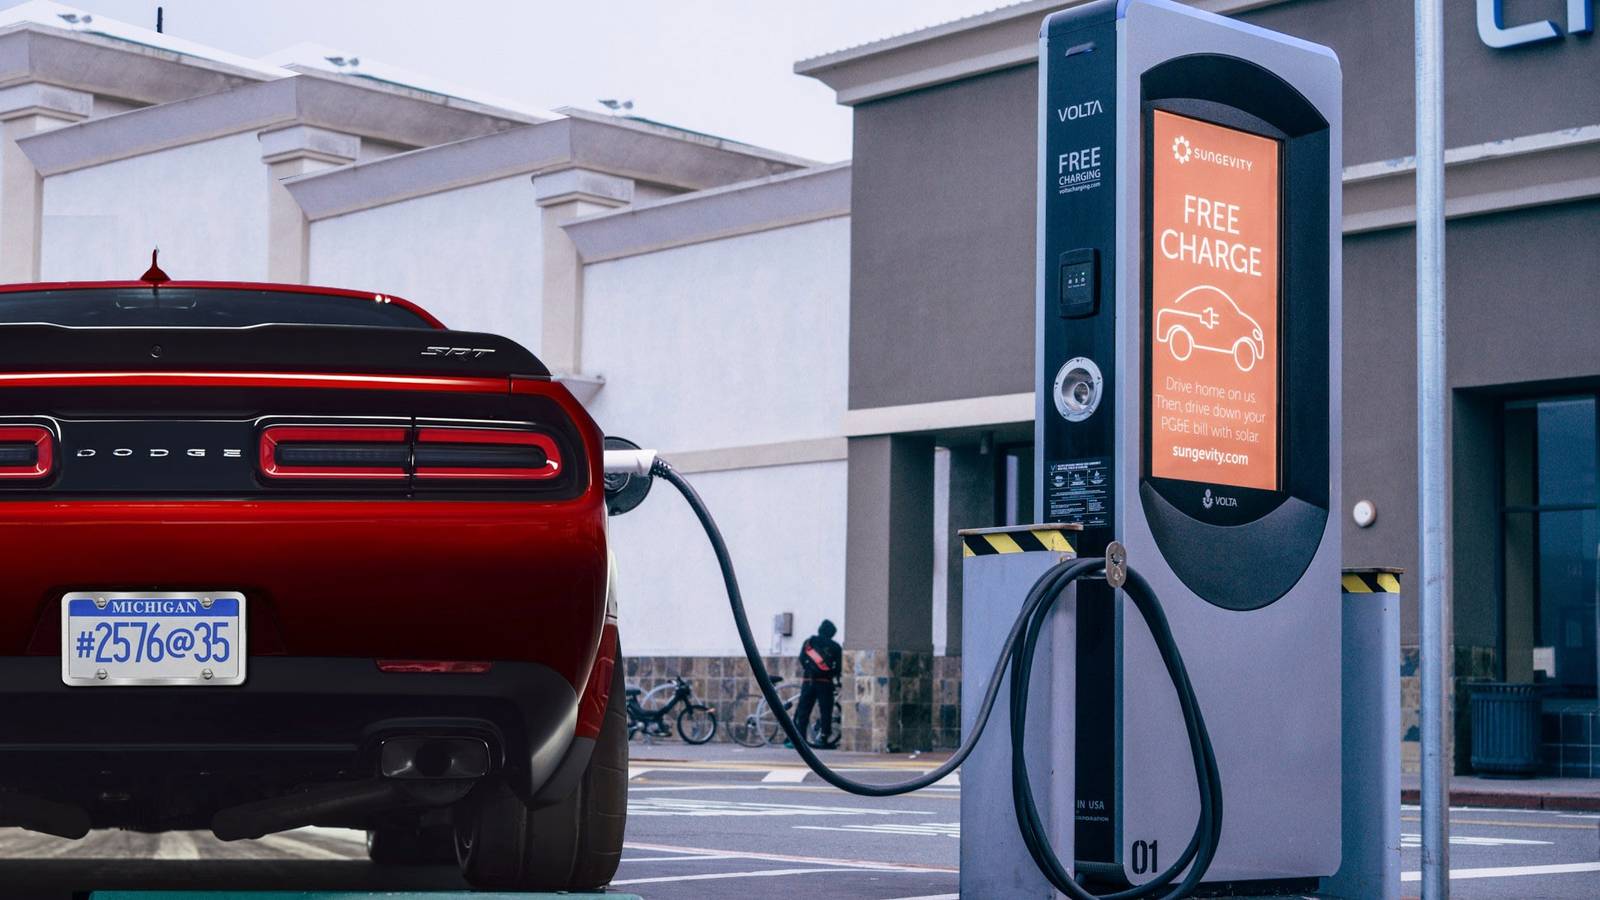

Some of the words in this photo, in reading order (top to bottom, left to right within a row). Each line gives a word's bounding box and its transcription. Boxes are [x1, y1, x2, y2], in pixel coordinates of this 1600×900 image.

[1058, 100, 1103, 122] VOLTA
[1059, 147, 1101, 174] FREE
[1194, 147, 1253, 171] SUNGEVITY
[1059, 169, 1101, 186] CHARGING
[1184, 194, 1240, 235] FREE
[1161, 229, 1263, 277] CHARGE
[420, 346, 497, 360] SRT
[1166, 376, 1193, 393] Drive
[1195, 382, 1225, 398] home
[1228, 391, 1241, 401] on
[1186, 400, 1210, 415] drive
[1213, 404, 1241, 420] down
[1244, 413, 1265, 424] your
[1161, 416, 1190, 433] PG&E
[1193, 422, 1208, 436] bill
[1211, 426, 1233, 439] with
[76, 448, 241, 458] DODGE
[1172, 445, 1249, 465] sungevity.com
[1215, 496, 1238, 507] VOLTA
[111, 601, 198, 614] MICHIGAN
[76, 621, 230, 664] #2576@35
[1077, 800, 1086, 809] IN
[1088, 800, 1105, 810] USA
[1131, 839, 1158, 875] 01
